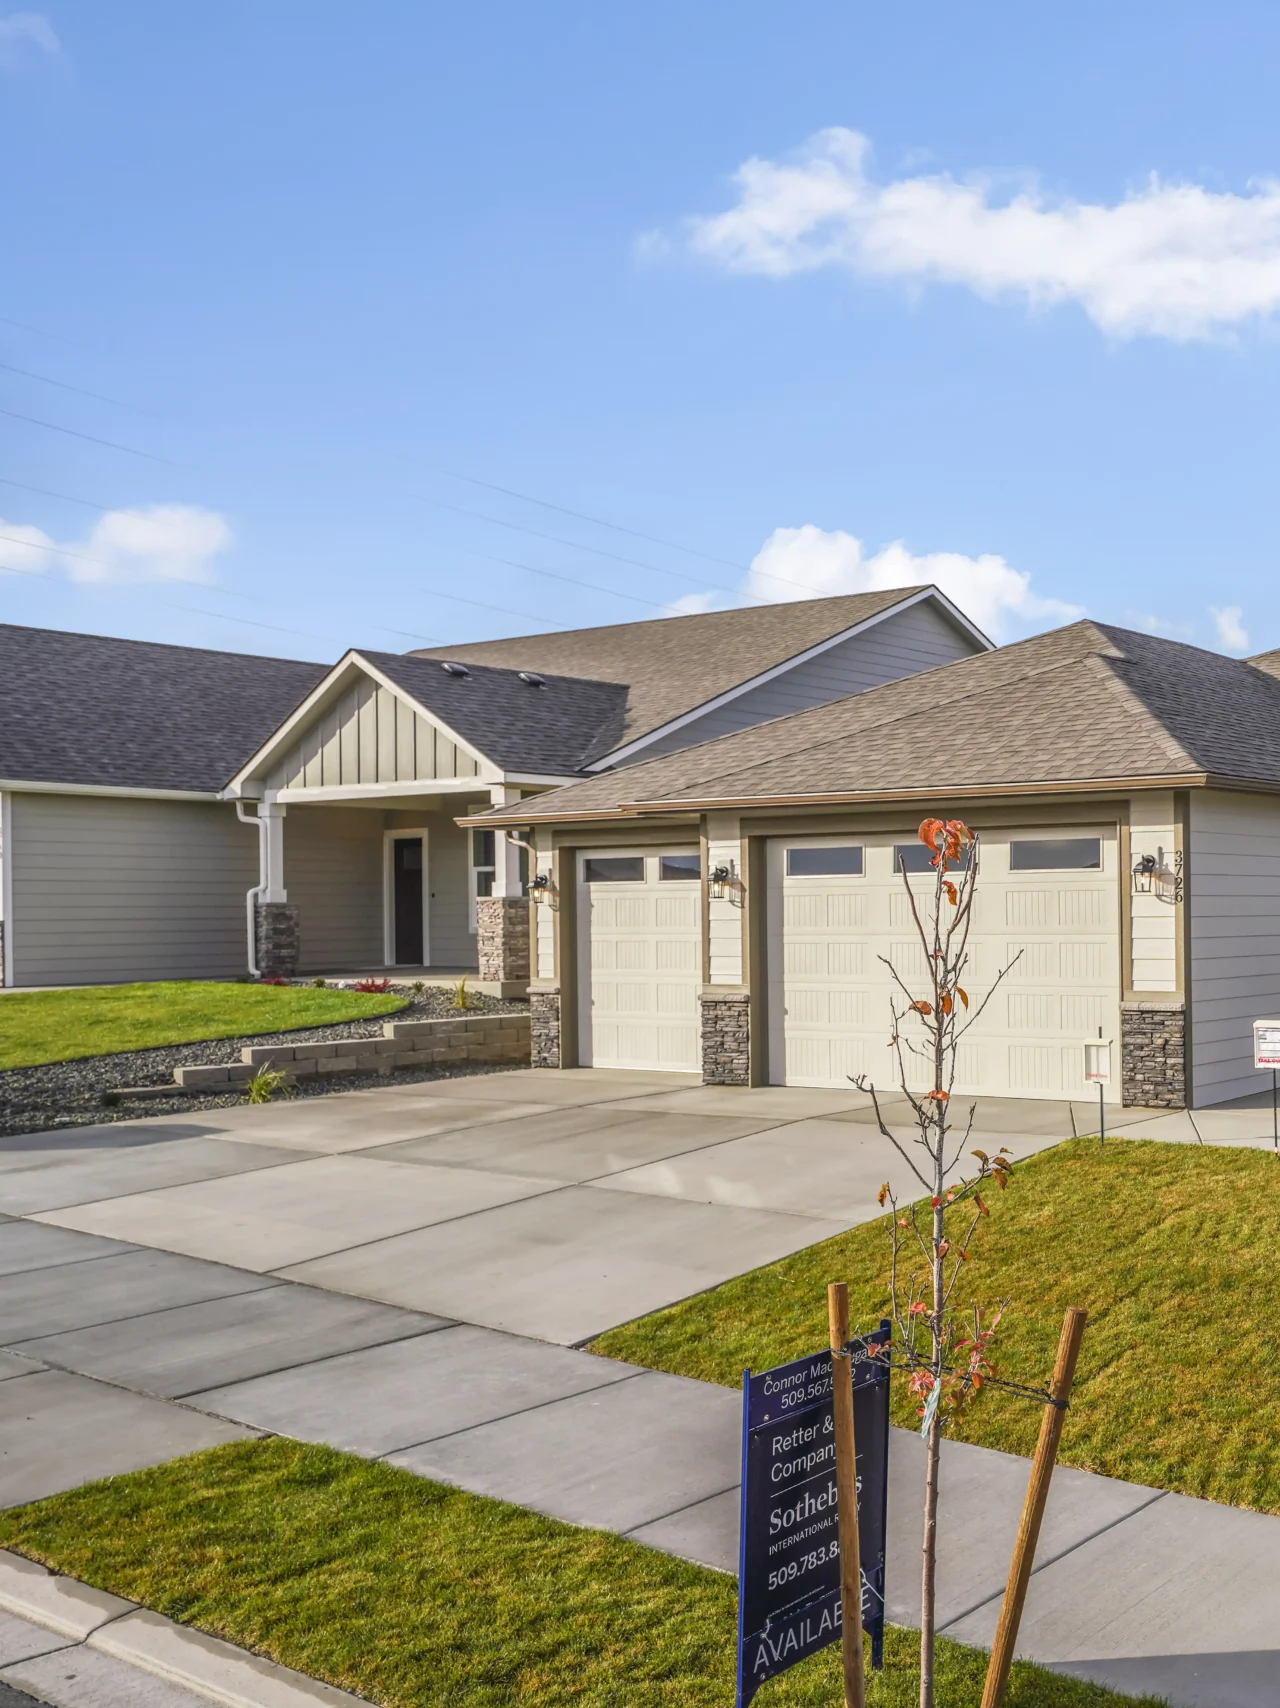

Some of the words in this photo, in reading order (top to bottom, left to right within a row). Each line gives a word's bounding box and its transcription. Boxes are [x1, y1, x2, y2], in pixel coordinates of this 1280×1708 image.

[1175, 850, 1183, 903] 3726
[763, 1370, 808, 1396] Connor
[772, 1423, 820, 1456] Retter
[822, 1415, 834, 1434] &
[769, 1517, 834, 1556] INTERNATIONAL
